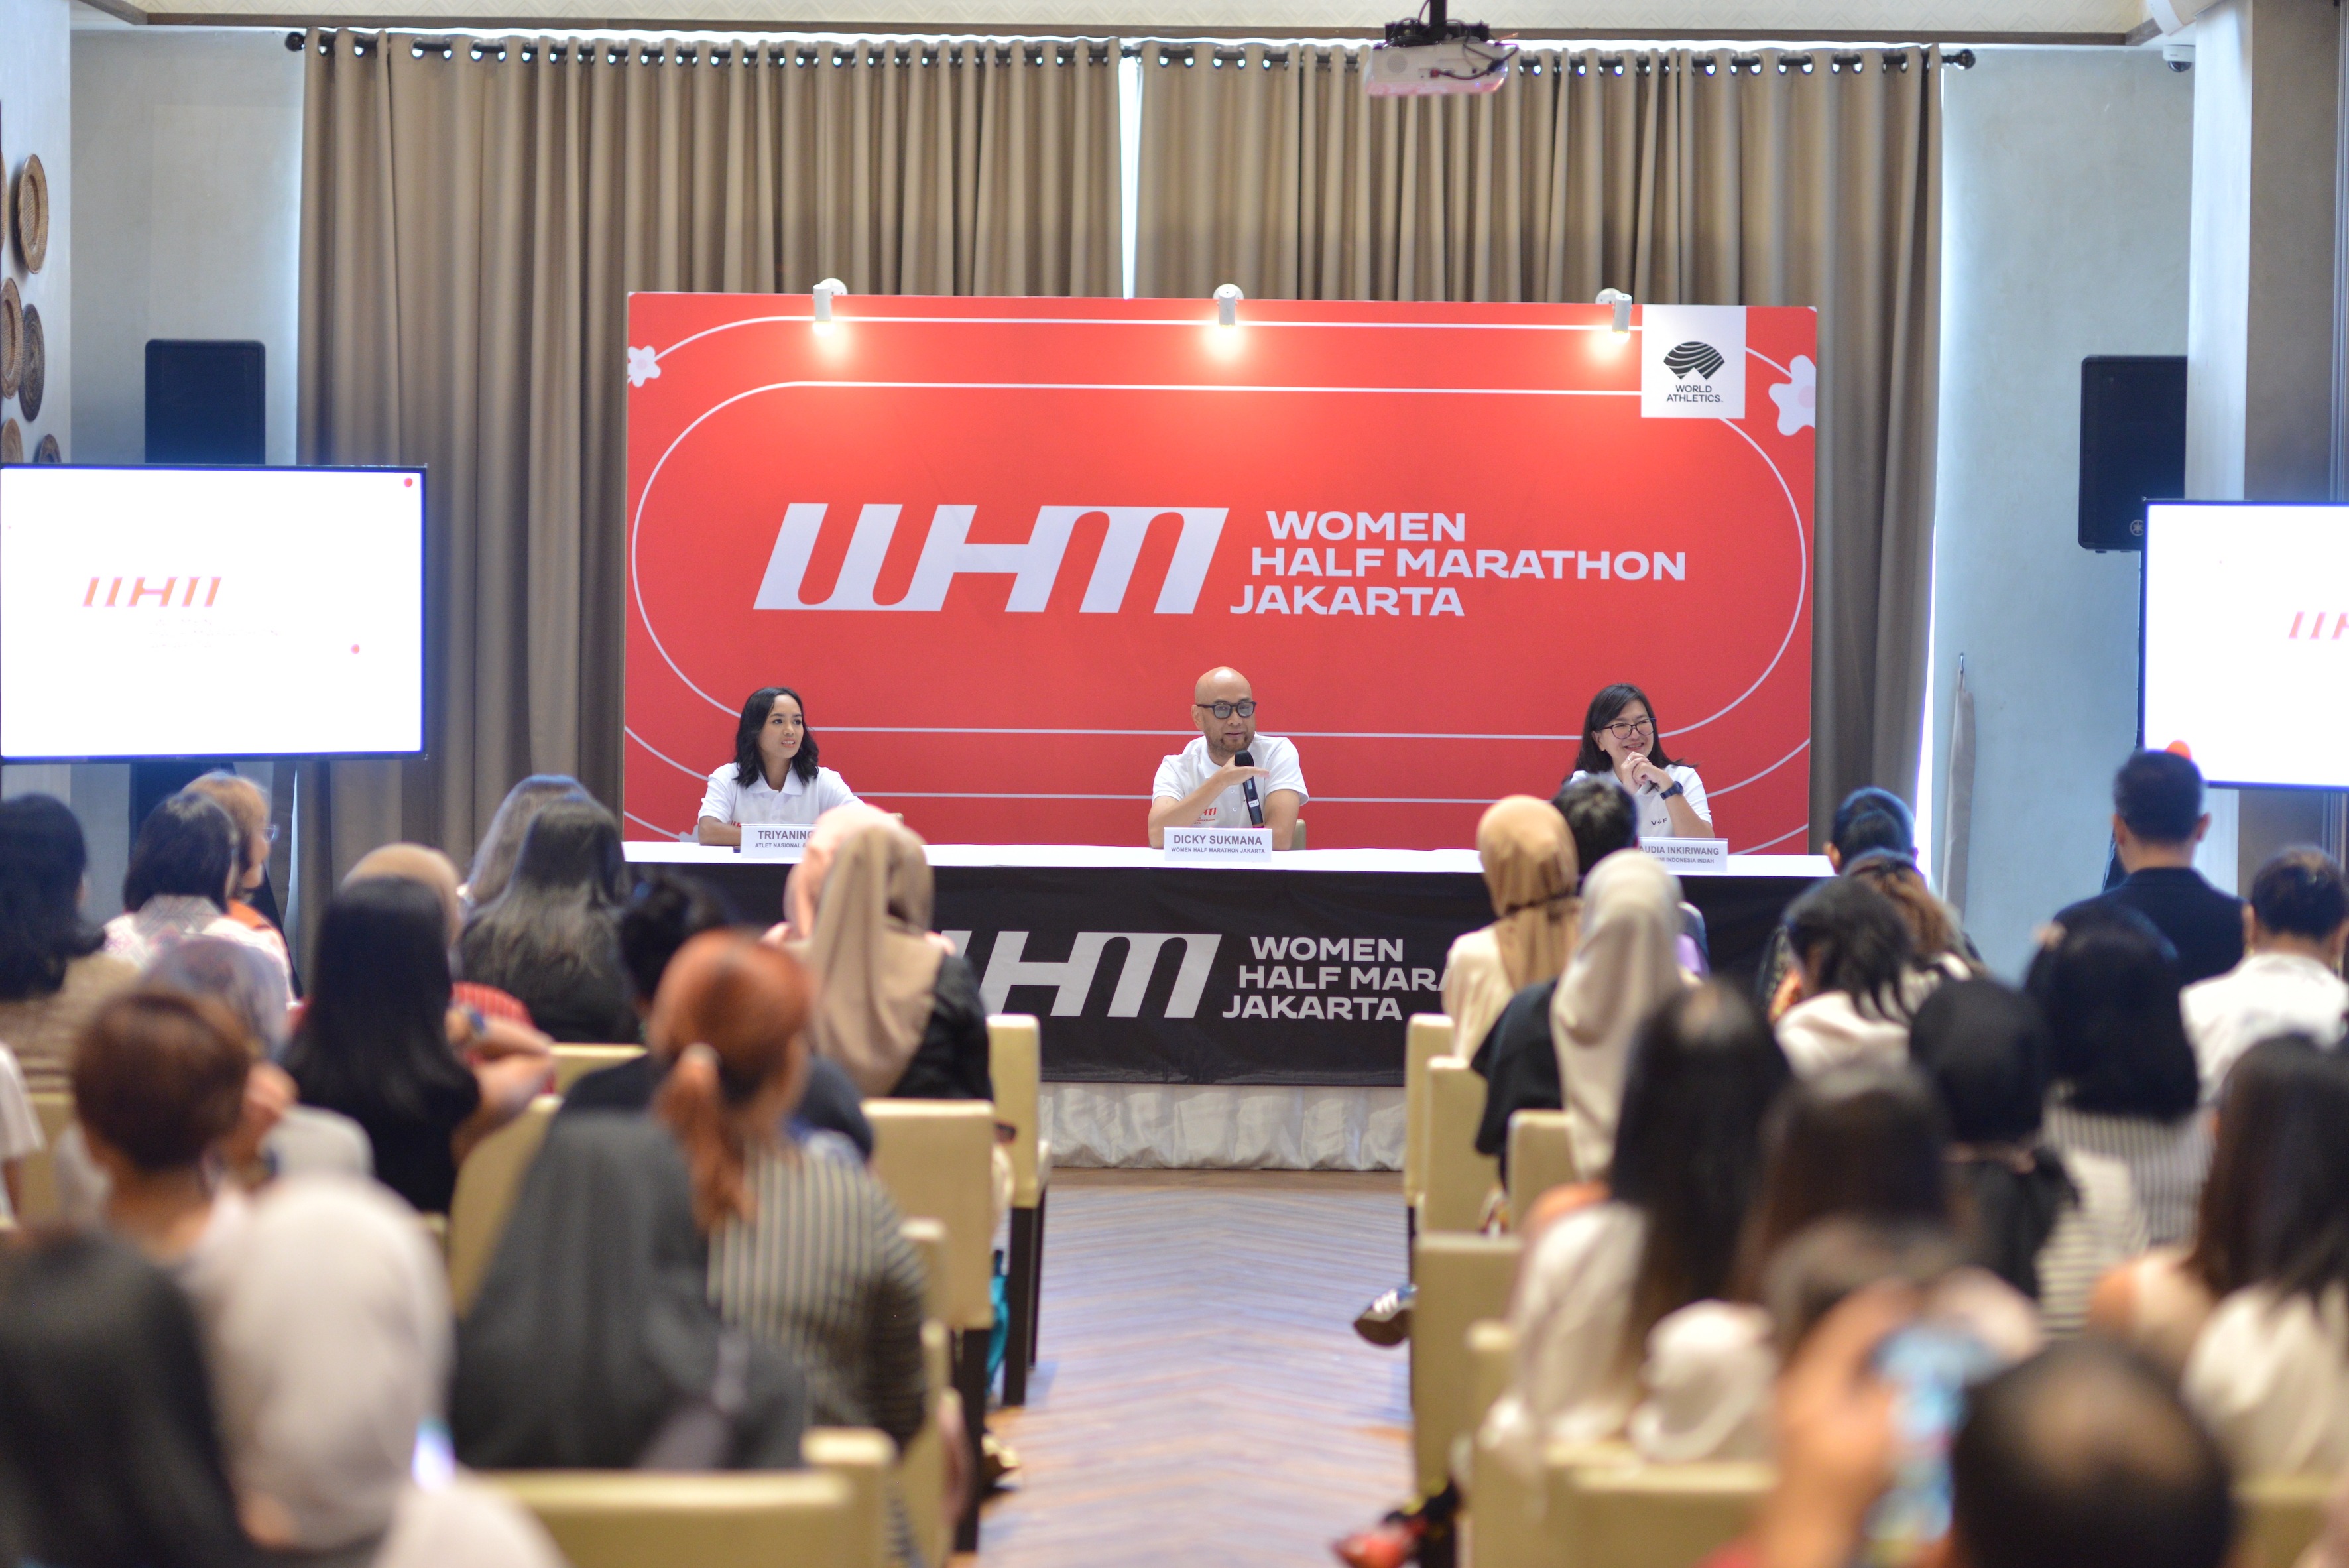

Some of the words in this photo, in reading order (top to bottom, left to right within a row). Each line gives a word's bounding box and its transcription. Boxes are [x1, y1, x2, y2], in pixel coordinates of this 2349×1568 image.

[1675, 385, 1713, 393] WORLD
[1266, 511, 1465, 542] WOMEN
[753, 503, 1230, 615] WHM
[1252, 547, 1384, 577] HALF
[1396, 548, 1686, 581] MARATHON
[1230, 584, 1465, 617] JAKARTA
[1174, 835, 1207, 844] DICKY
[1209, 835, 1262, 845] SUKMANA
[1667, 847, 1719, 855] INKIRIWANG
[1250, 936, 1404, 962] WOMEN
[1239, 965, 1341, 990] HALF
[1222, 995, 1403, 1021] JAKARTA
